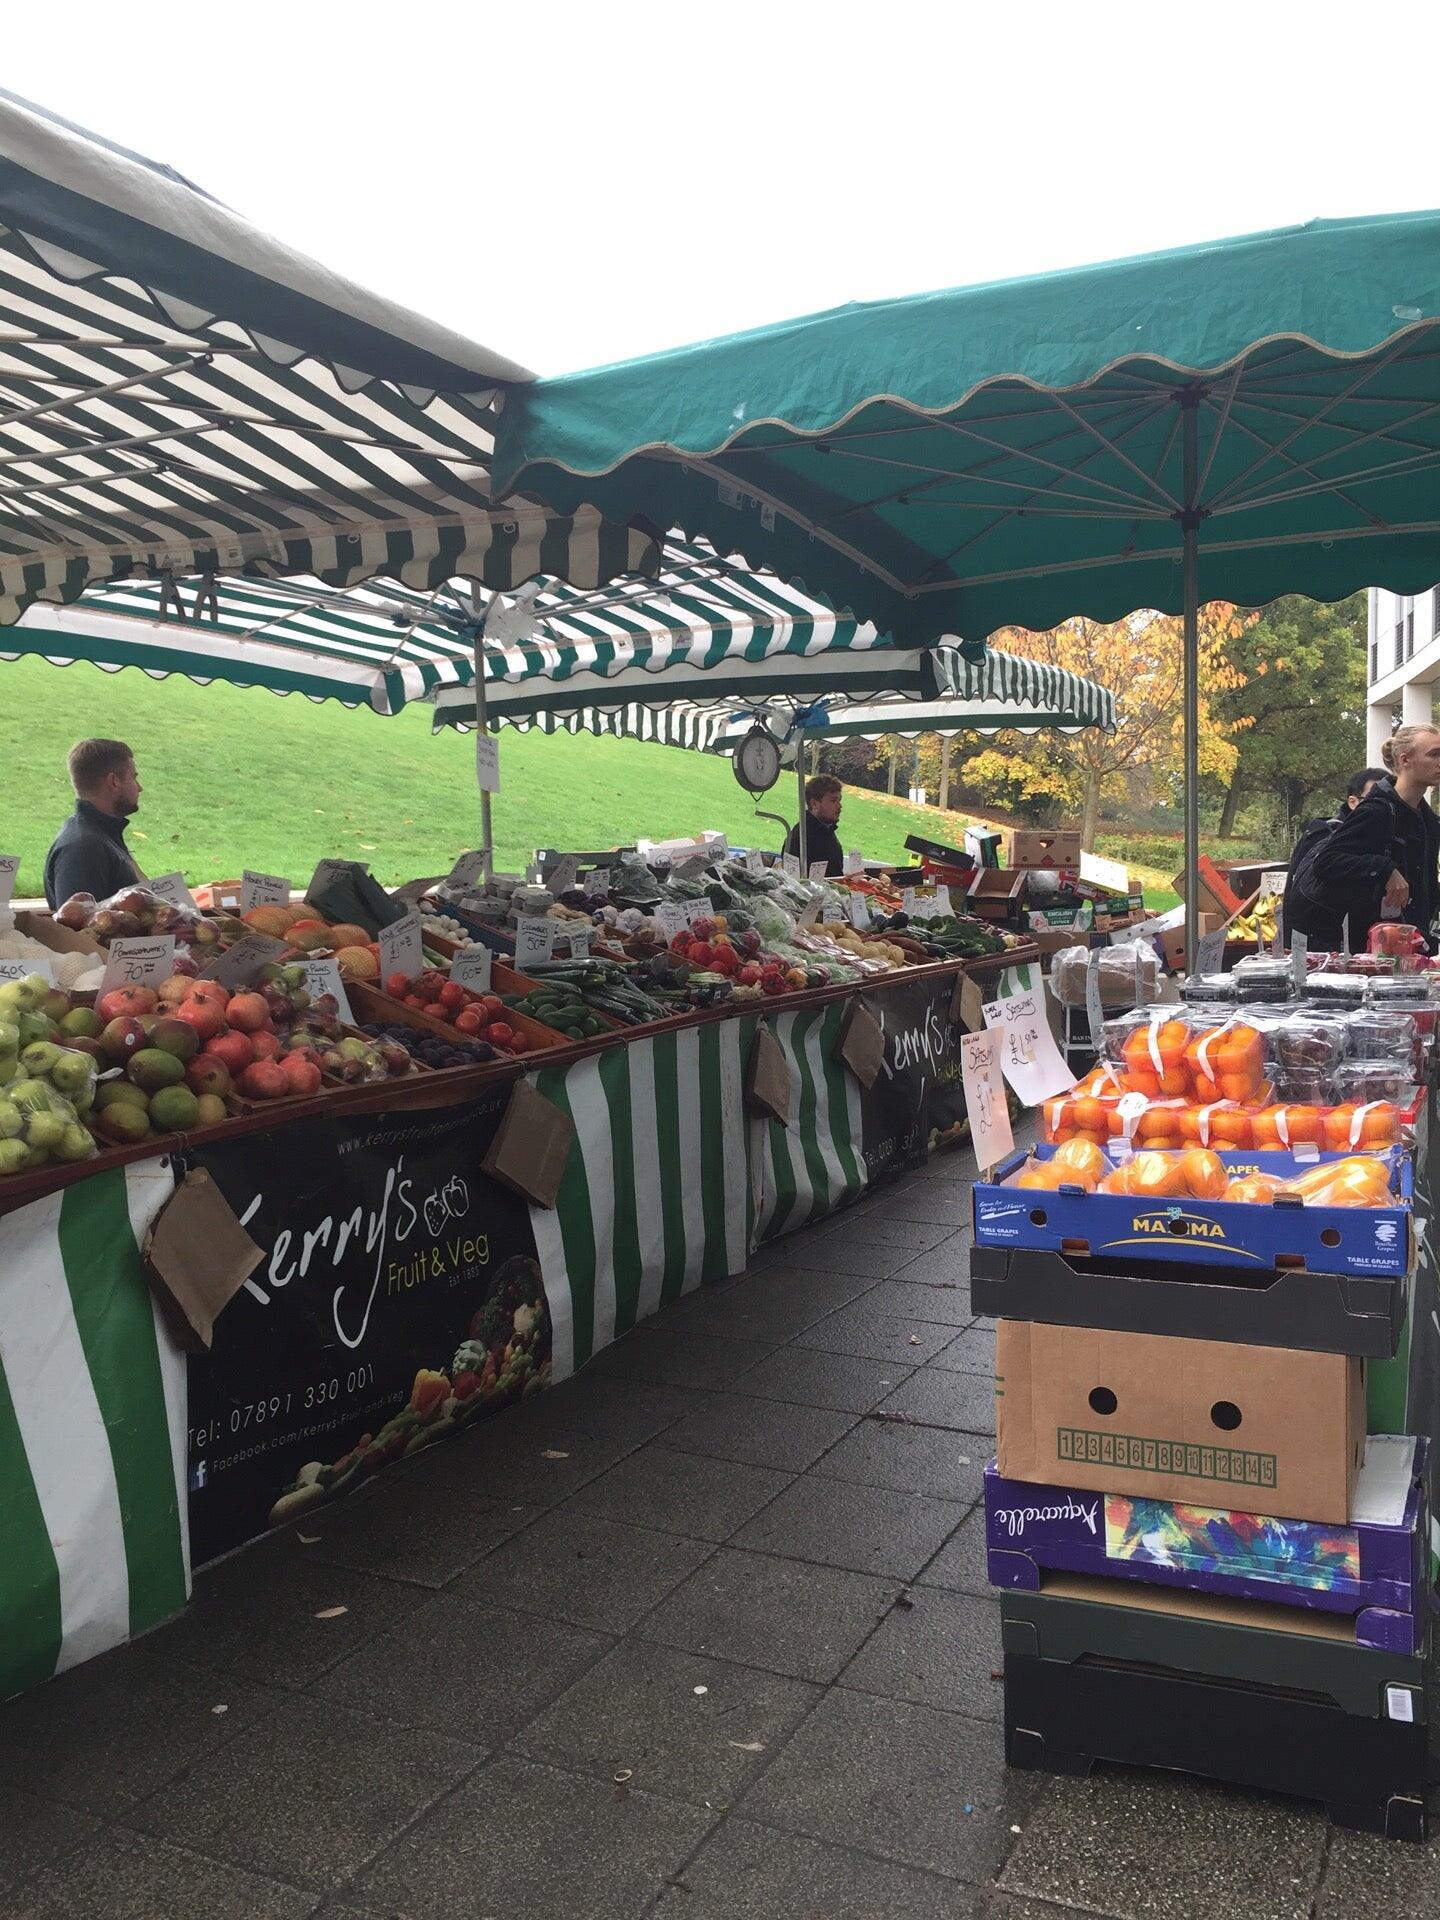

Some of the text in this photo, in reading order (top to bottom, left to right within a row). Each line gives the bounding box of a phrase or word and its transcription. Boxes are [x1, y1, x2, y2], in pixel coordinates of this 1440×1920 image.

[1133, 1218, 1226, 1238] MAMA
[388, 1234, 490, 1296] Fruit & Veg
[1347, 1256, 1400, 1266] TABLE GRAPES
[188, 1363, 374, 1452] Tel: 07891 330 001
[1062, 1435, 1273, 1480] 1 2 3 4 5 6 7 8 9 10 11 12 13 14 15
[994, 1494, 1098, 1536] Aquarelle
